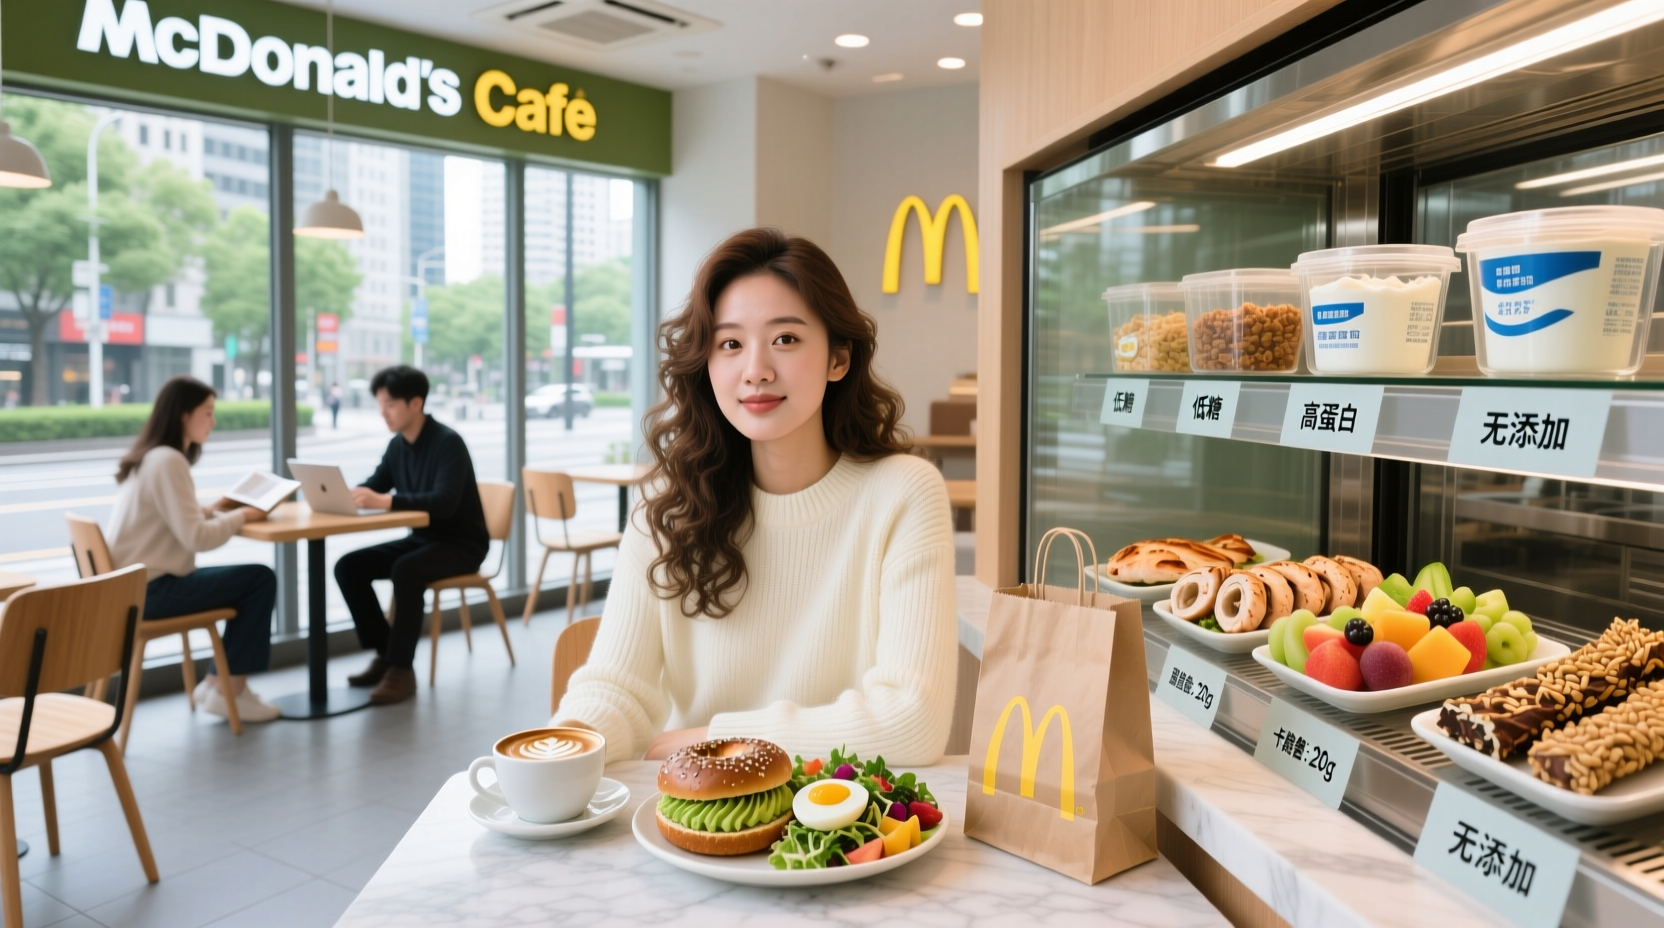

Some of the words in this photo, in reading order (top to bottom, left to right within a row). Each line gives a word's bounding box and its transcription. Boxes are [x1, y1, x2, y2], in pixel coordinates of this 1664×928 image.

[76, 0, 463, 117] McDonald's
[1193, 394, 1223, 420] 低糖
[1300, 401, 1358, 433] 高蛋白
[1480, 412, 1570, 450] 无添加
[1448, 820, 1537, 897] 无添加
